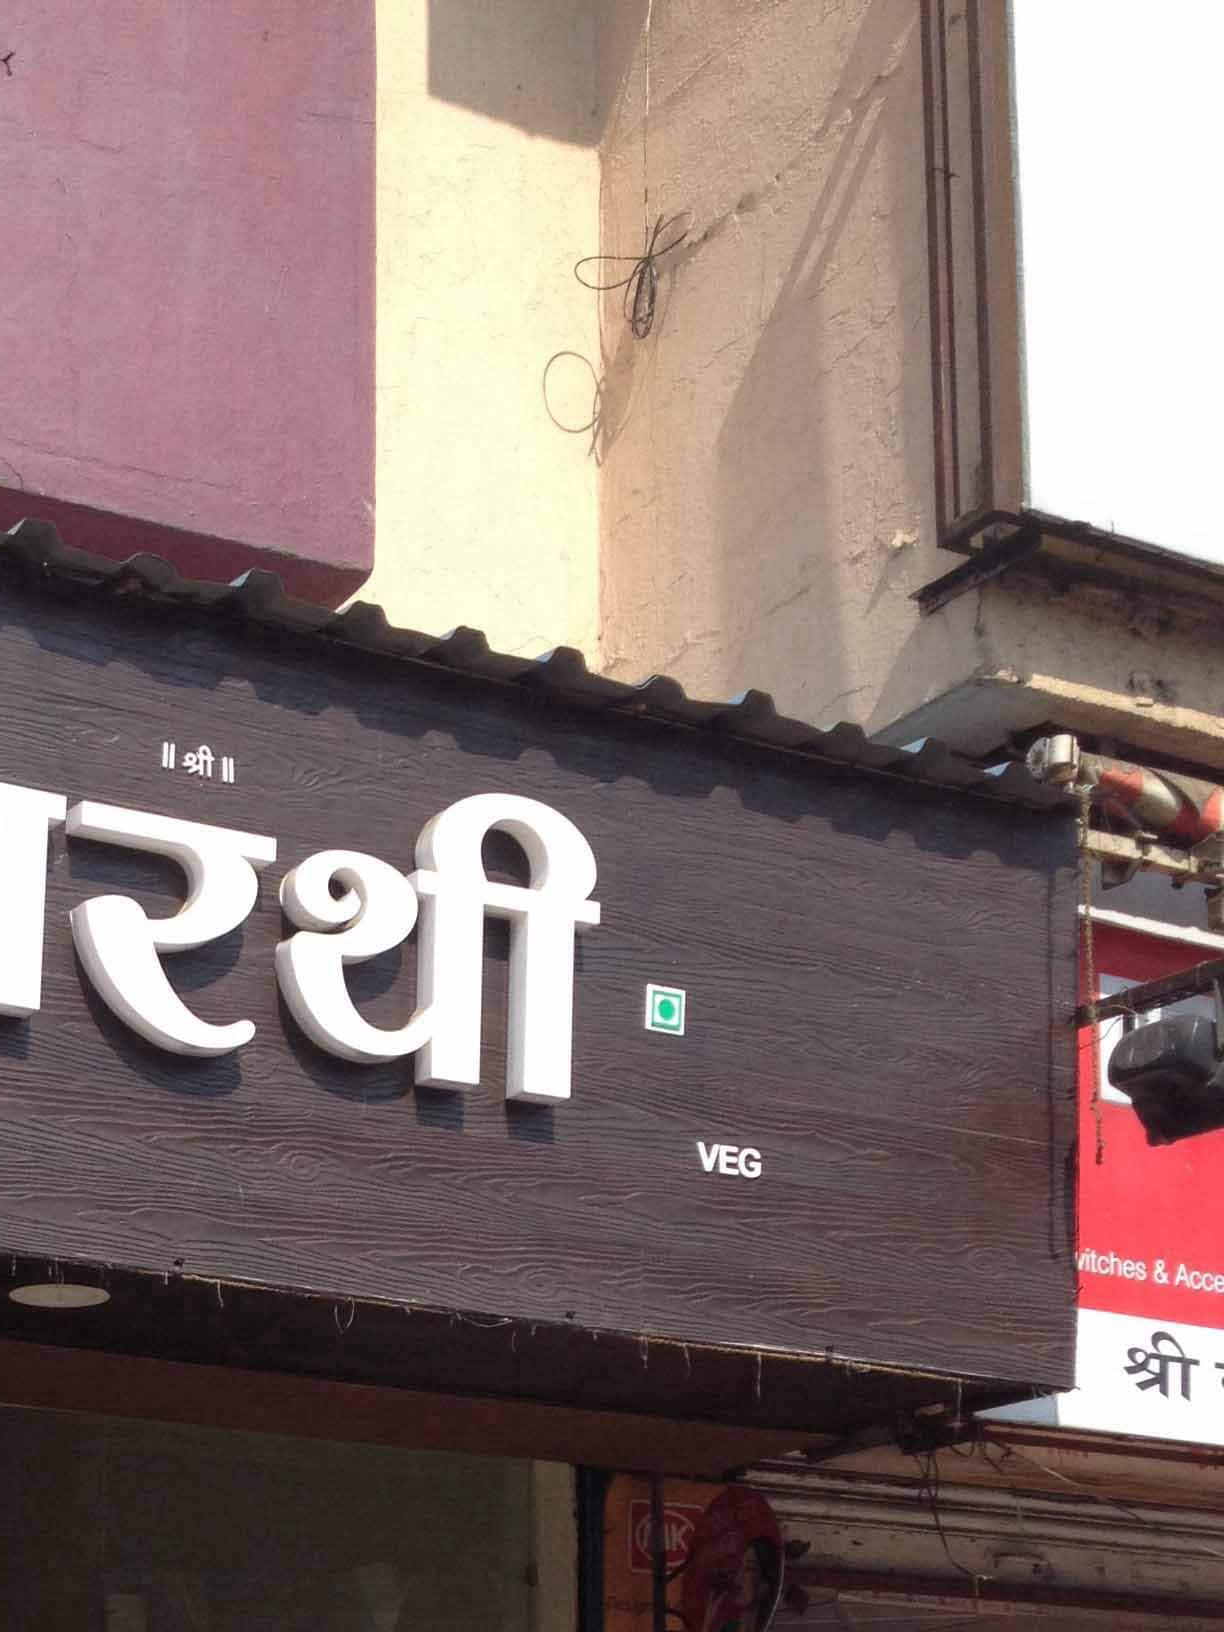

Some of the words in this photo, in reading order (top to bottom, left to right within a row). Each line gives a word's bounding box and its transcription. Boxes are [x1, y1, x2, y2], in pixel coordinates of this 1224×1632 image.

[696, 1141, 762, 1178] VEG
[1153, 1259, 1169, 1285] &
[1123, 1331, 1200, 1401] श्री
